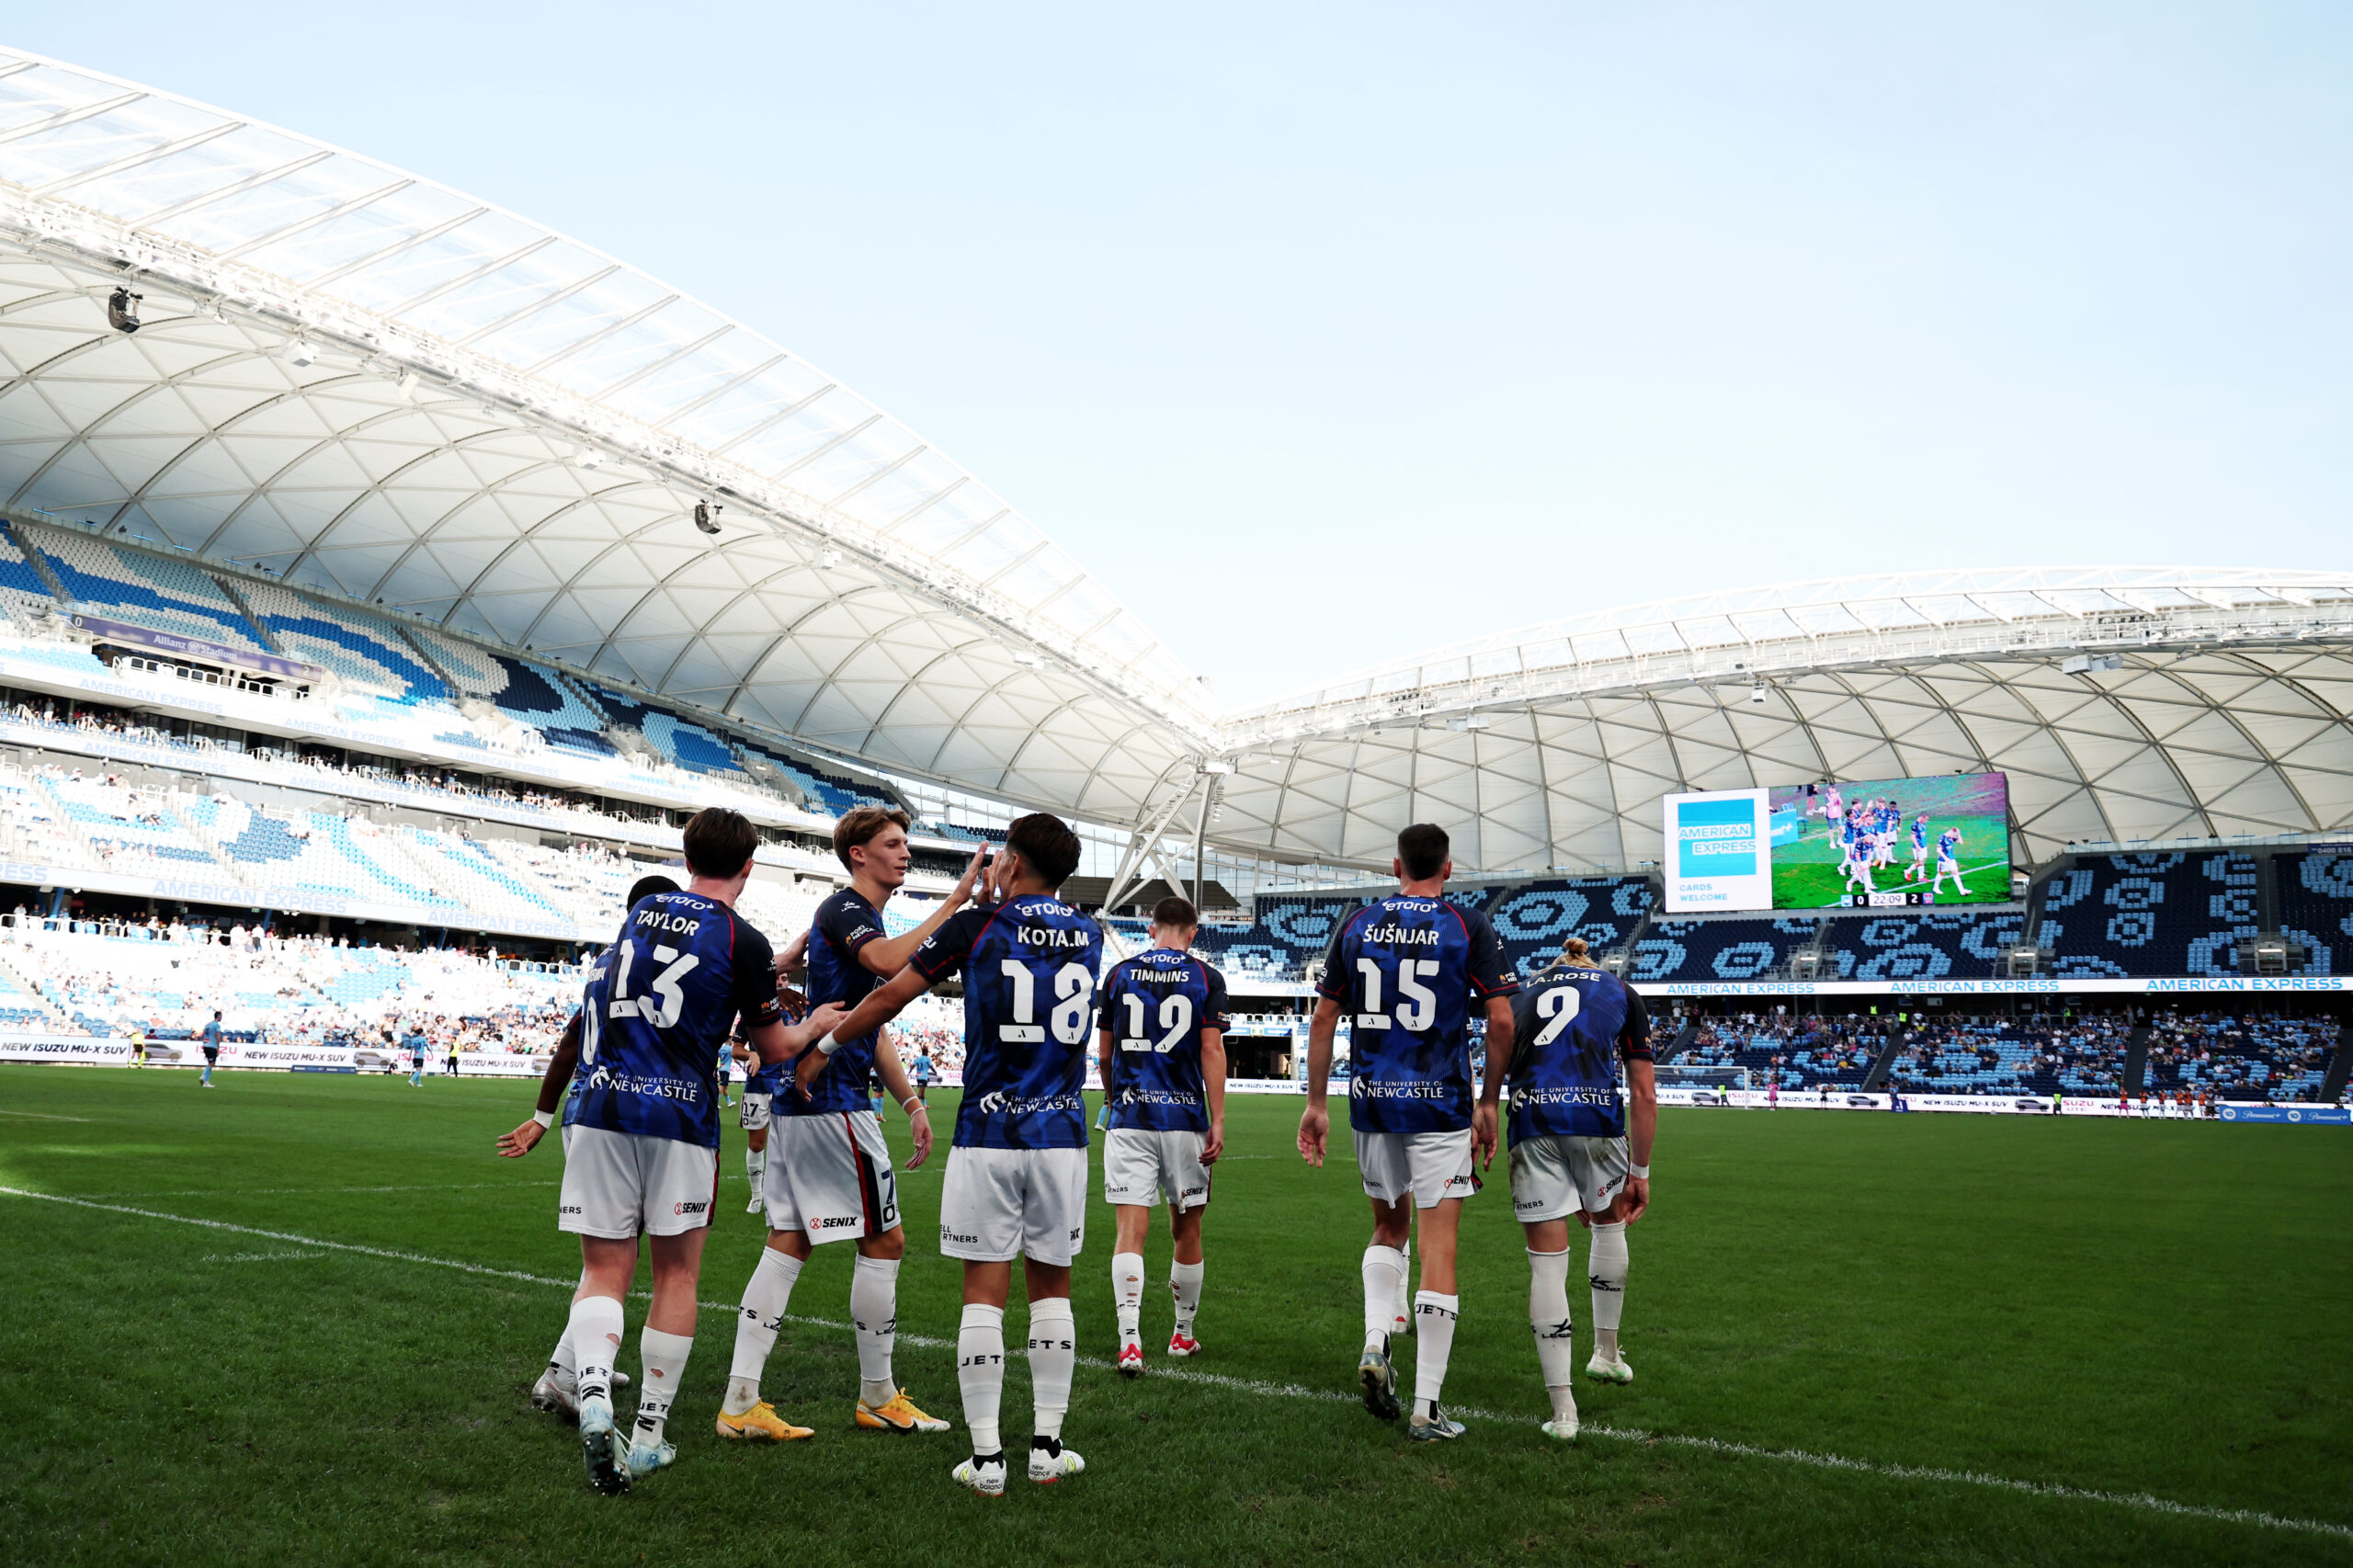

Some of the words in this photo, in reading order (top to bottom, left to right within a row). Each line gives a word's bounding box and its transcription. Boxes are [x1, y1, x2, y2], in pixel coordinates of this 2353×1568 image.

[153, 634, 187, 649] Allianz
[200, 644, 237, 661] Stadium
[79, 677, 155, 702] AMERICAN
[160, 693, 223, 714] EXPRESS
[284, 718, 347, 740] AMERICAN
[352, 731, 405, 749] EXPRESS
[84, 742, 160, 766] AMERICAN
[165, 756, 228, 775] EXPRESS
[290, 776, 353, 797] AMERICAN
[357, 788, 410, 804] EXPRESS
[1679, 826, 1750, 838] AMERICAN
[1694, 841, 1756, 854] EXPRESS
[1679, 883, 1712, 892] CARDS
[153, 880, 256, 905] AMERICAN
[264, 892, 347, 915] EXPRESS
[1679, 893, 1728, 902] WELCOME
[1857, 895, 1864, 904] 0
[1873, 895, 1902, 904] 22:09
[1911, 893, 1918, 903] 2
[427, 911, 509, 931] AMERICAN
[514, 919, 580, 938] EXPRESS
[636, 910, 700, 937] TAYLOR
[1017, 926, 1090, 948] KOTA.M
[1363, 923, 1439, 945] ŠUŠNJAR
[608, 938, 699, 1028] 13
[1130, 969, 1190, 983] TIMMINS
[1526, 971, 1602, 988] LA.ROSE
[1666, 983, 1741, 994] AMERICAN
[1746, 983, 1815, 994] EXPRESS
[1890, 981, 1974, 993] AMERICAN
[1982, 980, 2060, 992] EXPRESS
[2146, 979, 2245, 991] AMERICAN
[2251, 977, 2343, 990] EXPRESS
[1357, 958, 1440, 1031] 15
[999, 959, 1095, 1045] 18
[1120, 993, 1193, 1053] 19
[1533, 986, 1580, 1046] 9
[1, 1041, 31, 1051] NEW
[33, 1043, 69, 1053] ISUZU
[70, 1044, 102, 1054] MU-X
[104, 1046, 127, 1055] SUV
[195, 1045, 238, 1055] ISZU
[244, 1051, 267, 1059] NEW
[270, 1051, 300, 1061] ISUZU
[301, 1052, 325, 1062] MU-X
[326, 1054, 346, 1062] SUV
[633, 1075, 683, 1086] UNIVERSITY
[687, 1081, 698, 1089] OF
[608, 1079, 698, 1103] NEWCASTLE
[1367, 1087, 1444, 1098] NEWCASTLE
[1006, 1097, 1080, 1114] NEWCASTLE
[1137, 1095, 1197, 1105] NEWCASTLE
[1529, 1093, 1611, 1106] NEWCASTLE
[743, 1102, 759, 1118] 17
[881, 1168, 894, 1205] 7
[683, 1202, 708, 1213] SENIX
[1517, 1200, 1544, 1210] RTNERS
[823, 1216, 858, 1228] SENIX
[941, 1233, 978, 1244] RTNERS
[1415, 1304, 1457, 1321] JETS
[1029, 1339, 1072, 1349] ETS
[961, 1355, 1004, 1367] JET
[579, 1366, 608, 1380] JET
[641, 1403, 669, 1413] JET
